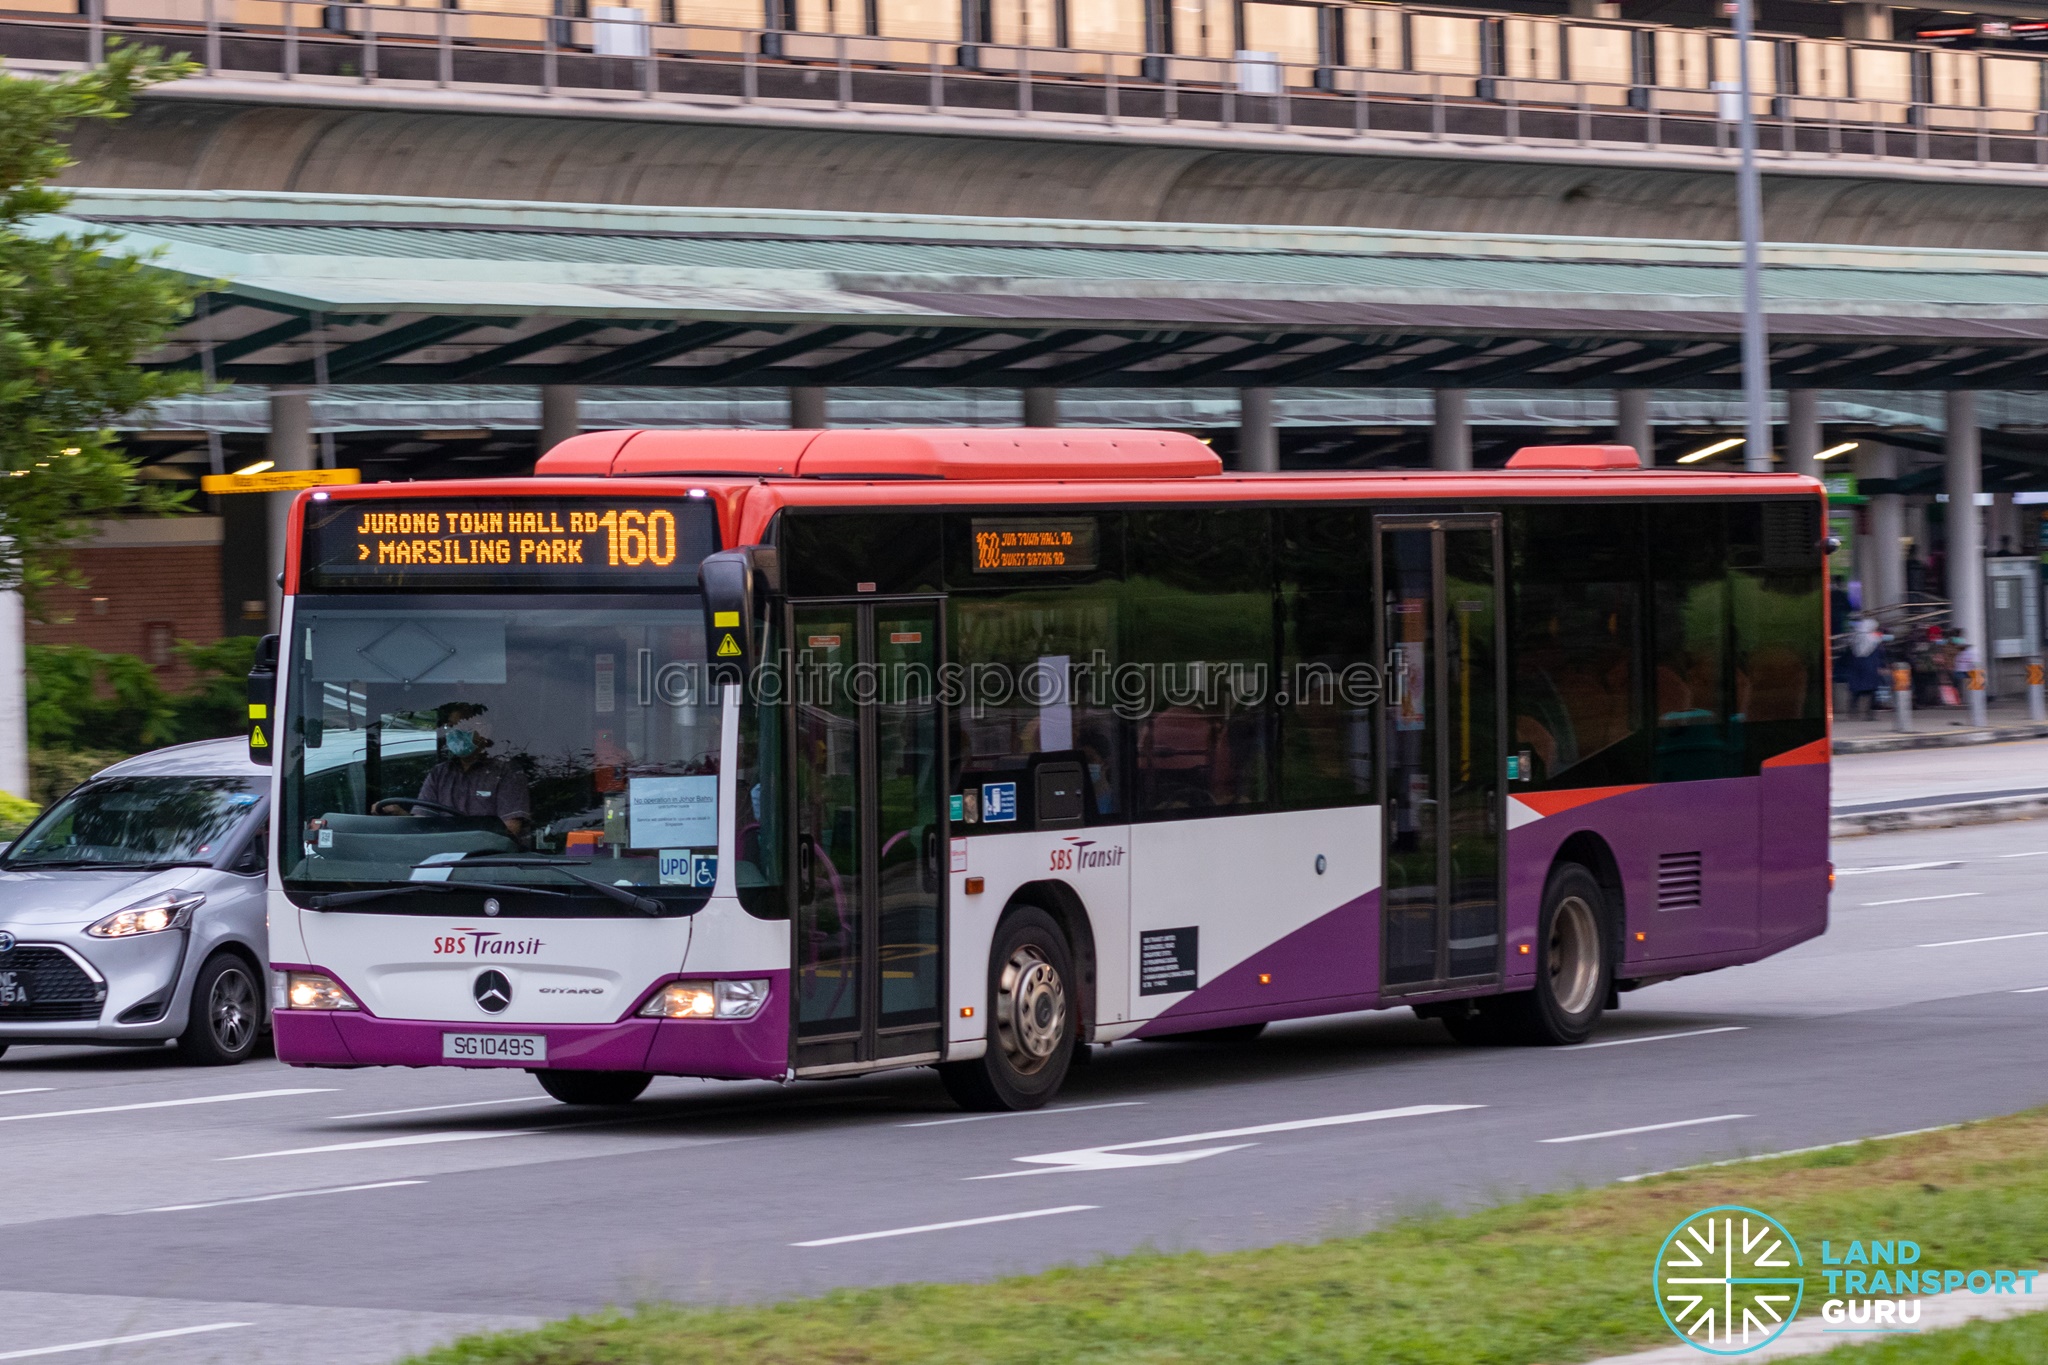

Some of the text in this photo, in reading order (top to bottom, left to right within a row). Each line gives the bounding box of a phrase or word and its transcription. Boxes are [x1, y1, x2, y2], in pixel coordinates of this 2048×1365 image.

[358, 511, 599, 534] JURONG TOWN HALL RD
[599, 509, 676, 566] 160
[1017, 532, 1039, 546] TOWN
[379, 539, 583, 565] MARSILING PARK
[661, 858, 689, 876] UPD
[1050, 840, 1126, 873] SBS Transit
[433, 931, 547, 958] SBS Transit
[454, 1036, 535, 1056] SG1049S
